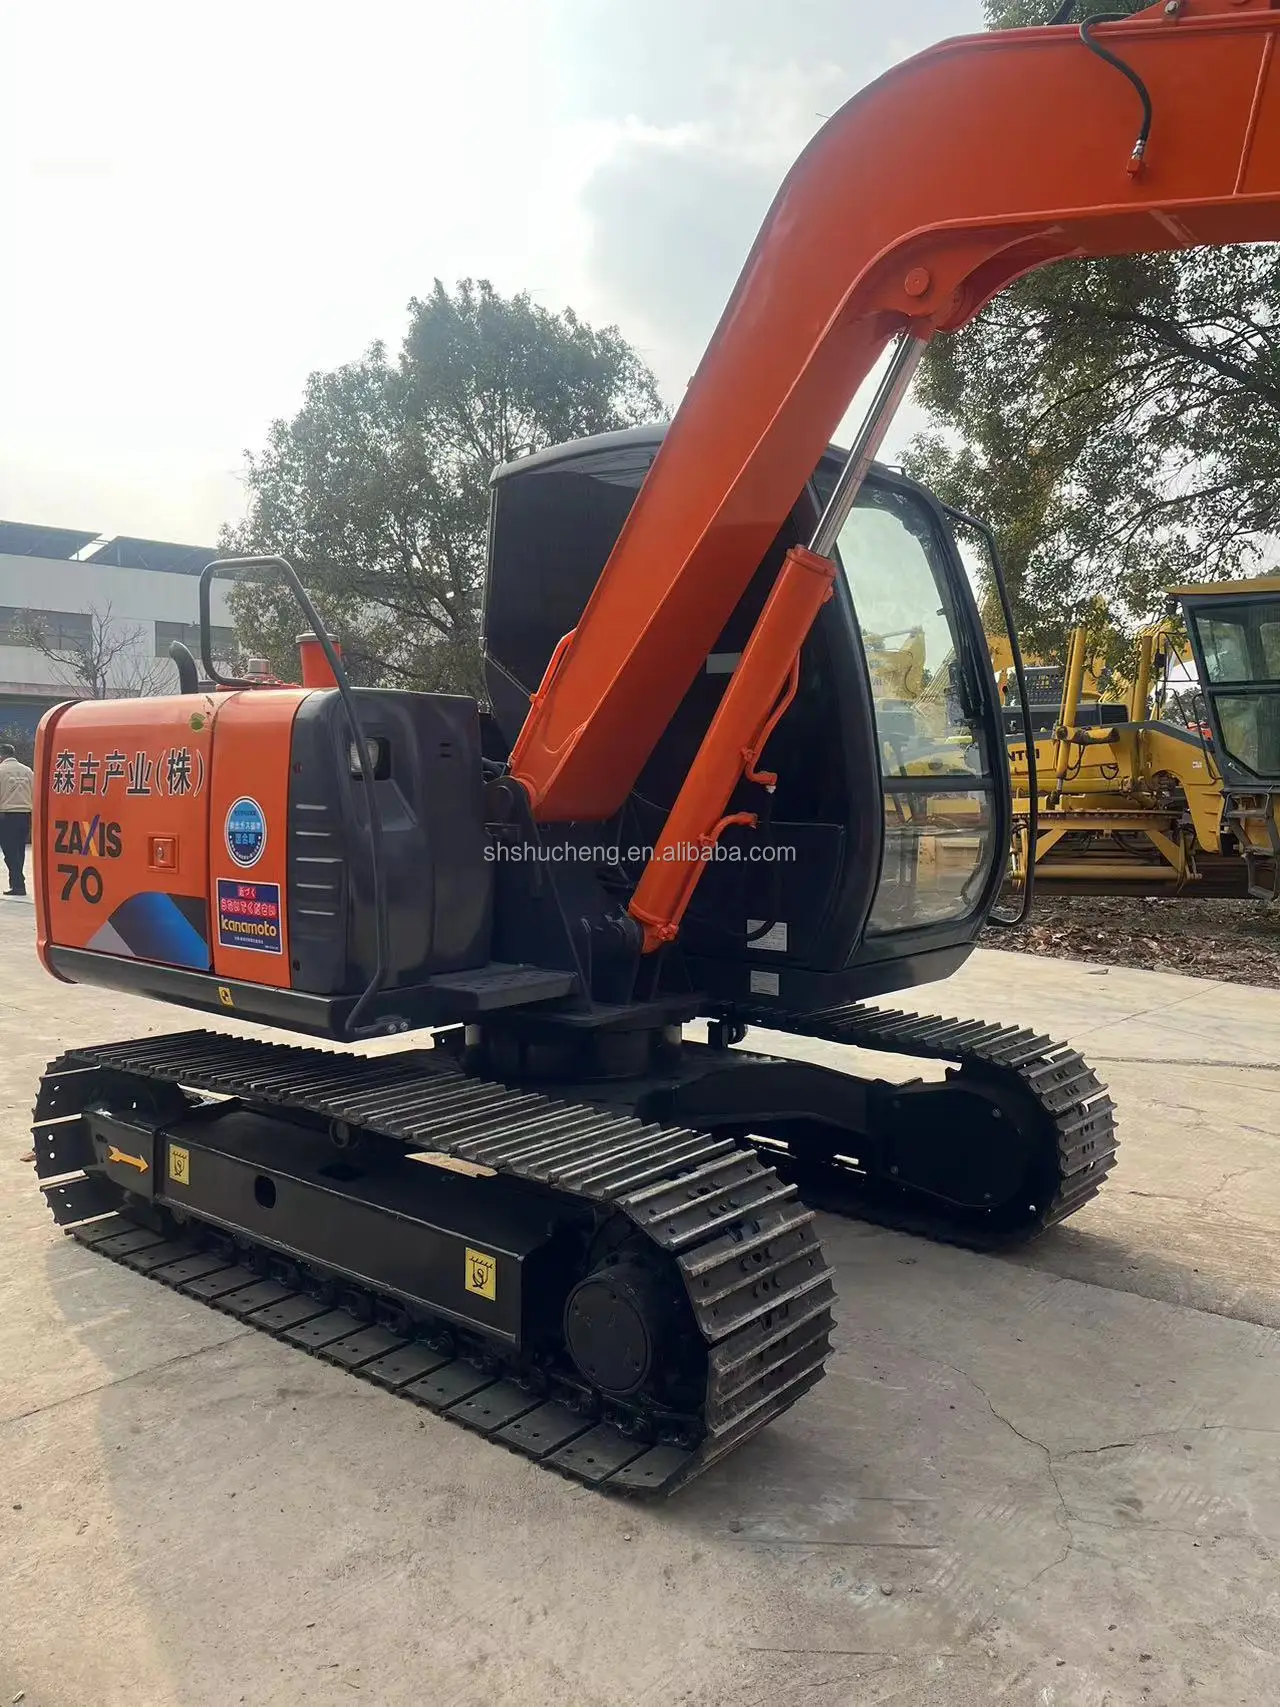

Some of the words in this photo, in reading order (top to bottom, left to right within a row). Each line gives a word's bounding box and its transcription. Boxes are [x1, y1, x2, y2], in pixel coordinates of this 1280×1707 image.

[54, 814, 122, 857] ZAXIS
[57, 864, 103, 904] 70
[221, 914, 277, 937] kanamoto
